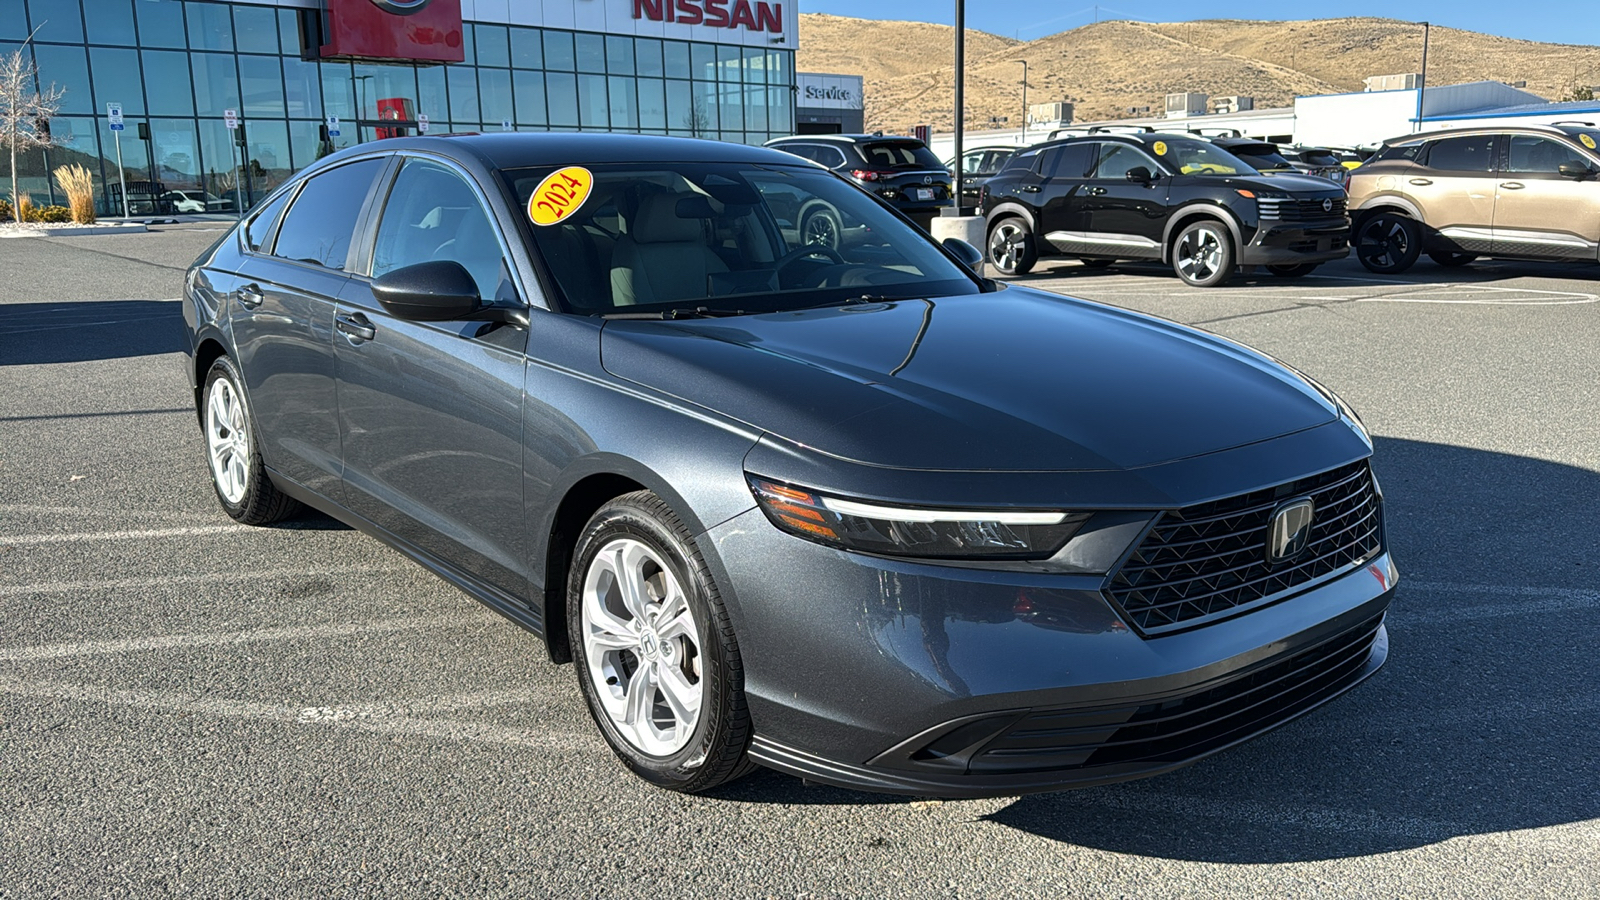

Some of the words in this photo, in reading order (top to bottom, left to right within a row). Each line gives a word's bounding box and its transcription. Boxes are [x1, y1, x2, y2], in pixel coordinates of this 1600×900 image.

[632, 0, 783, 33] NISSAN
[805, 85, 851, 101] Service
[537, 172, 583, 218] 2024
